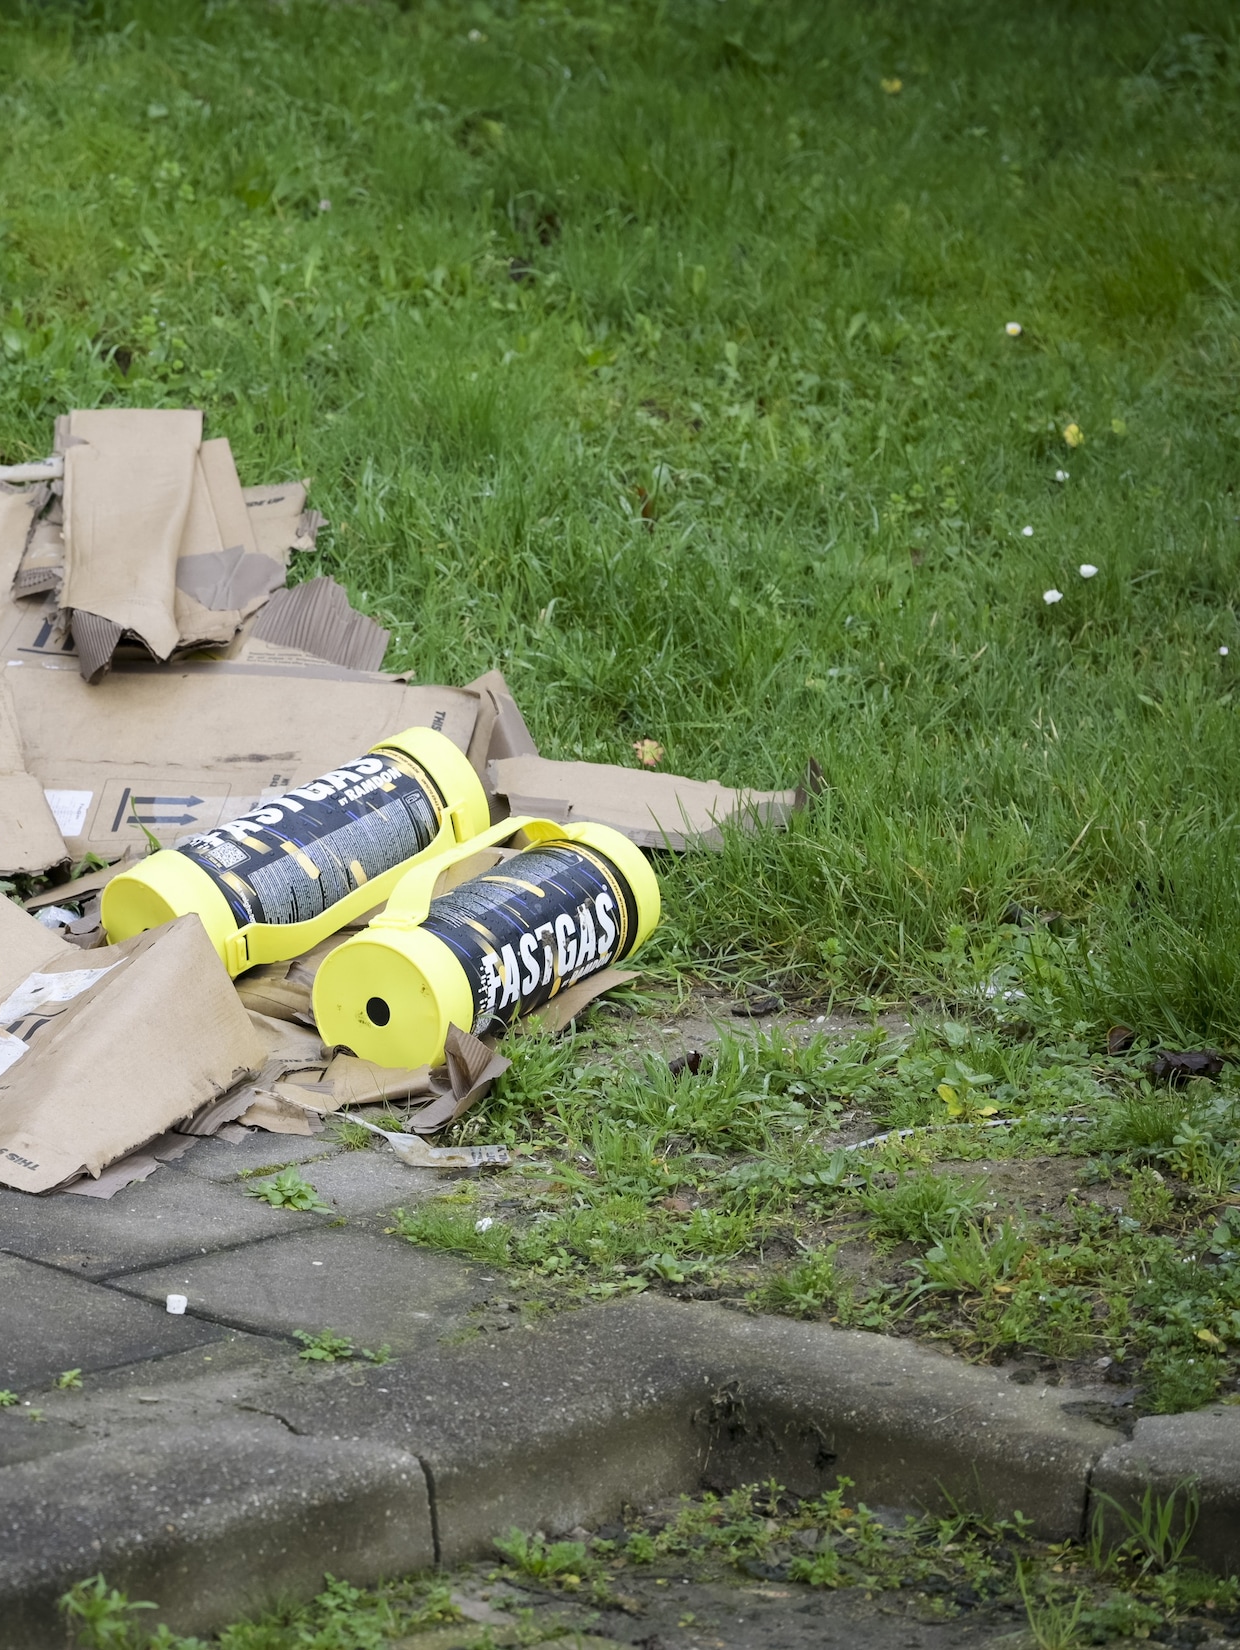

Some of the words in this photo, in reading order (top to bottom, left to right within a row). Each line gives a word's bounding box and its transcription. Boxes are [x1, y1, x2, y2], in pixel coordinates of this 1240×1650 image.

[344, 766, 402, 802] RAMDON
[480, 891, 616, 1011] FASTGAS
[5, 1152, 40, 1171] THIS
